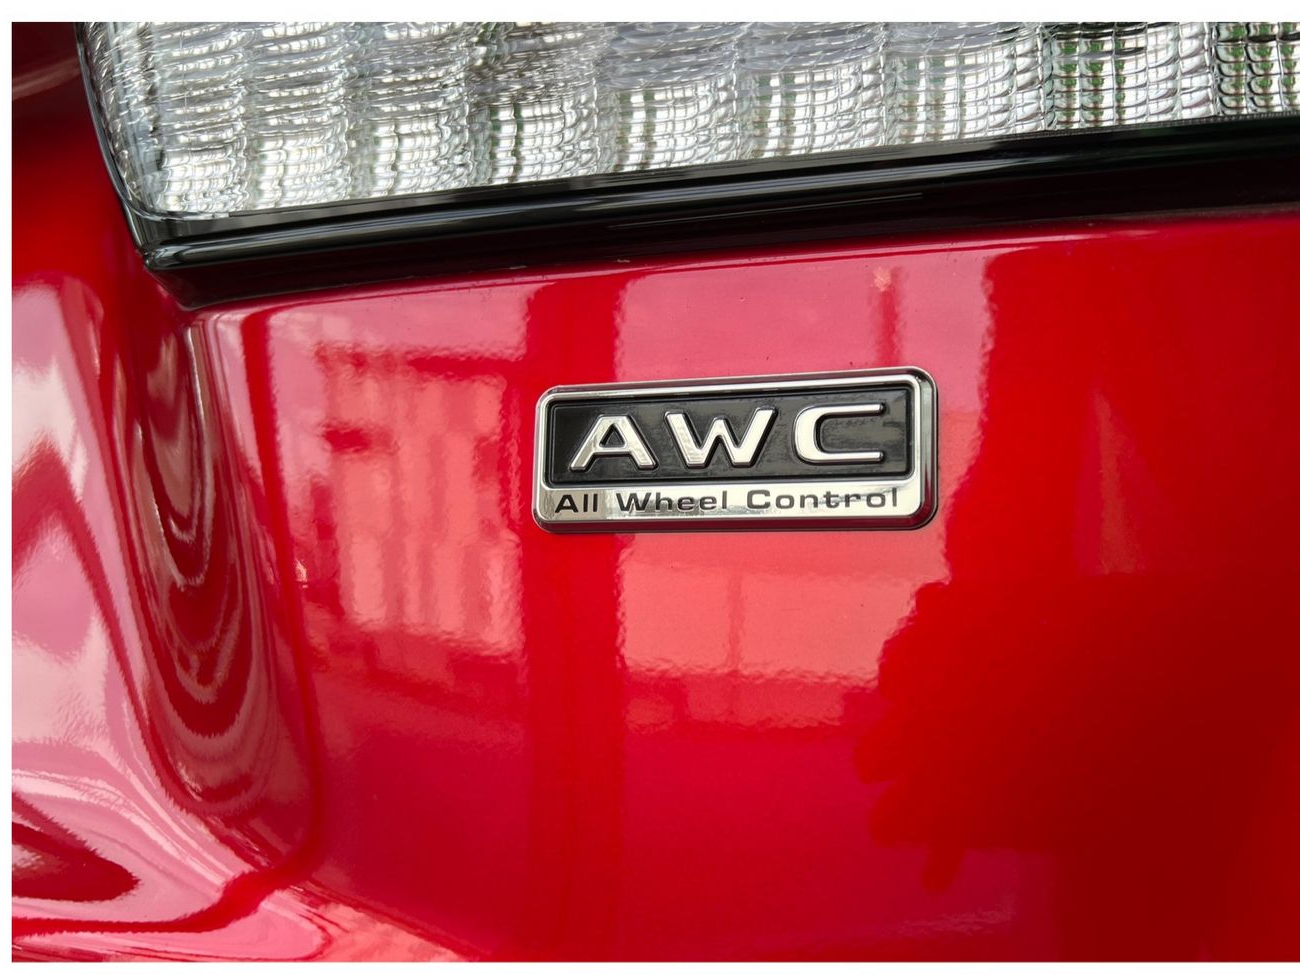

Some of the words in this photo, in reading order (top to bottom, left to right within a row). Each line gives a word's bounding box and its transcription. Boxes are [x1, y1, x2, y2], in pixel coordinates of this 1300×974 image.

[569, 402, 887, 471] AWC
[555, 493, 598, 514] All
[617, 490, 728, 513] Wheel
[746, 487, 898, 510] Control
